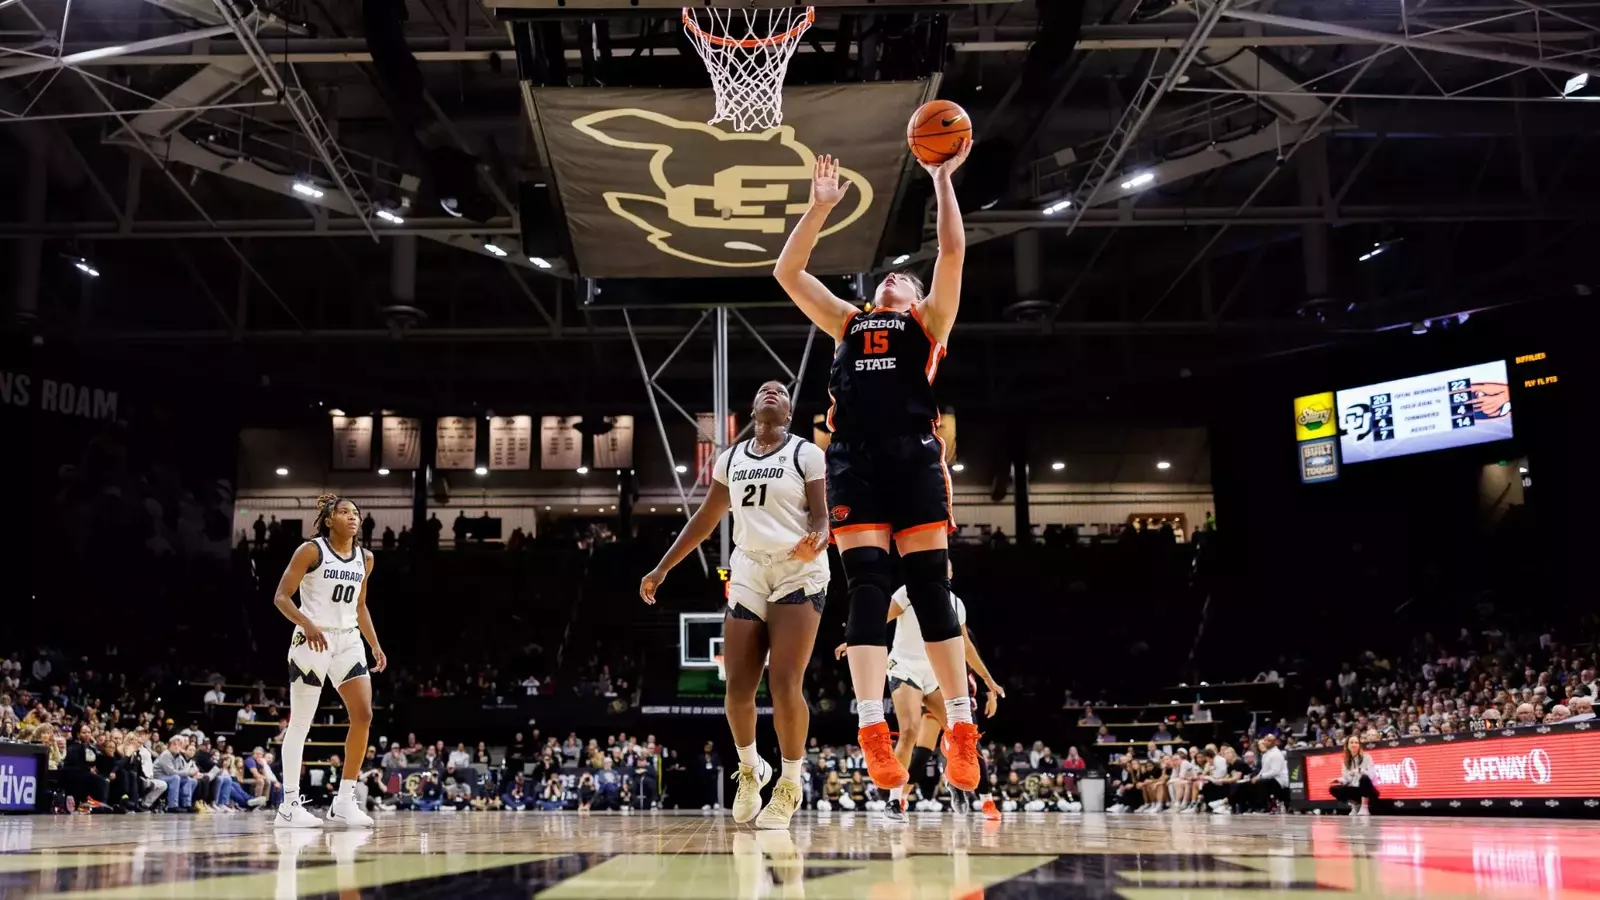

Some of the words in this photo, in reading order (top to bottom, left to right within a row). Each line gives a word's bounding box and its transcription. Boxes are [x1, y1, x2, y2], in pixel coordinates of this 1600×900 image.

[850, 319, 906, 335] OREGON
[863, 330, 889, 355] 15
[855, 357, 897, 371] STATE
[41, 379, 118, 422] ROAM
[1373, 394, 1388, 406] 20
[1451, 380, 1466, 391] 22
[1374, 407, 1389, 420] 27
[1378, 418, 1387, 428] 4
[1457, 405, 1466, 415] 4
[1380, 431, 1388, 440] 7
[1456, 416, 1471, 428] 14
[1304, 444, 1332, 458] BUILT
[732, 468, 784, 482] COLORADO
[1306, 465, 1334, 477] TOUGH
[741, 484, 768, 507] 21
[331, 584, 355, 603] 00
[1463, 755, 1527, 782] SAFEWAY
